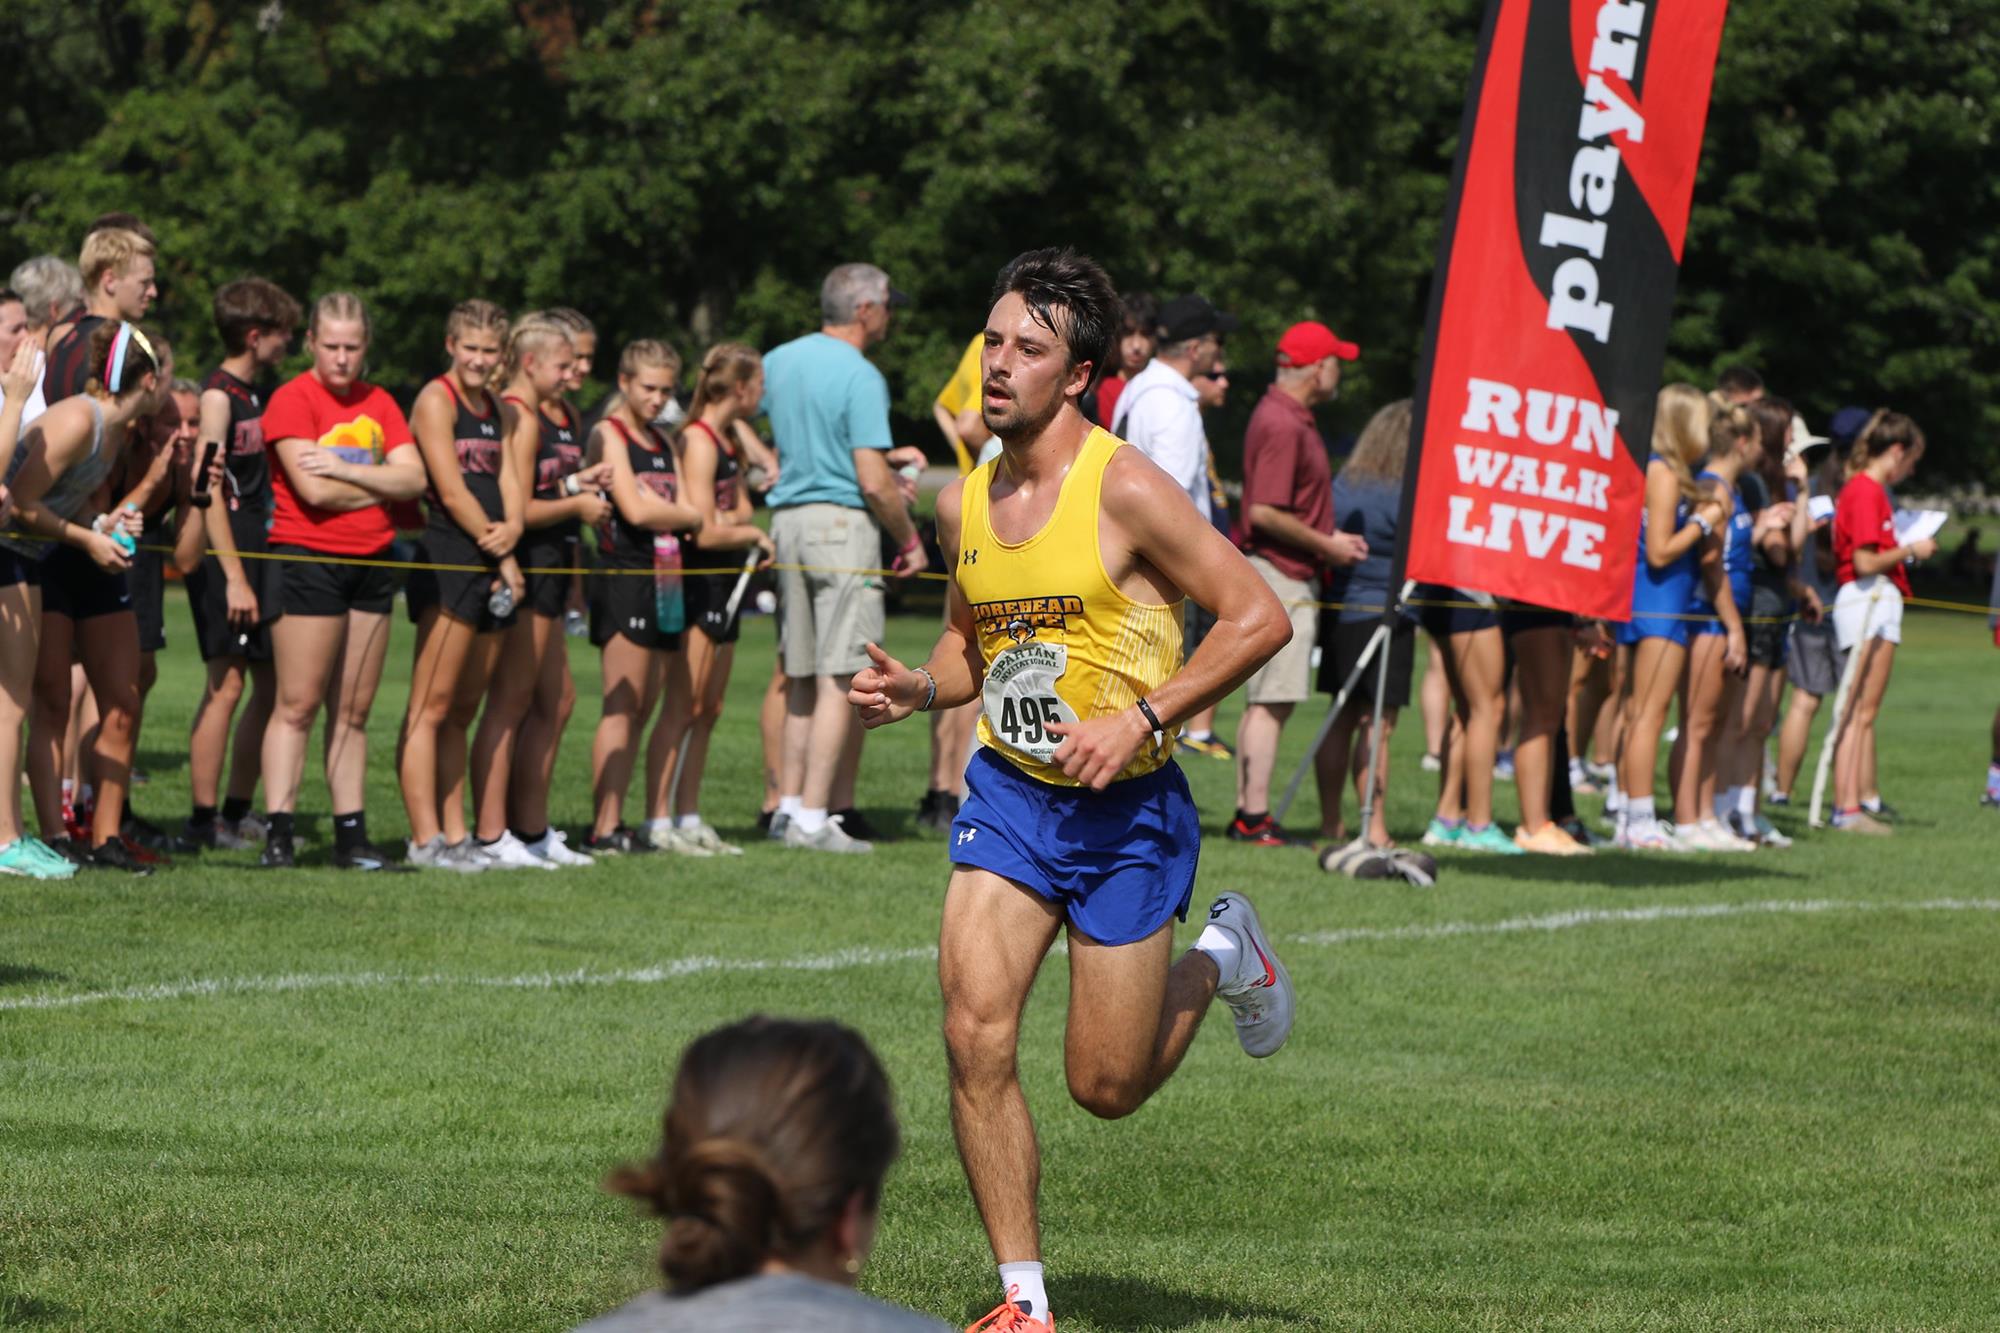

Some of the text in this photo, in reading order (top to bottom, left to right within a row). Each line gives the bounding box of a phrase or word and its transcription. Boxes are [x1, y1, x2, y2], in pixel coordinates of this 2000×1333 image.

[1460, 377, 1620, 461] RUN
[1454, 443, 1612, 512] WALK
[1446, 495, 1606, 571] LIVE
[984, 613, 1063, 633] STTE
[991, 647, 1057, 679] SPARTAN
[1000, 658, 1060, 684] INVITATIONAL
[1001, 696, 1064, 744] 495
